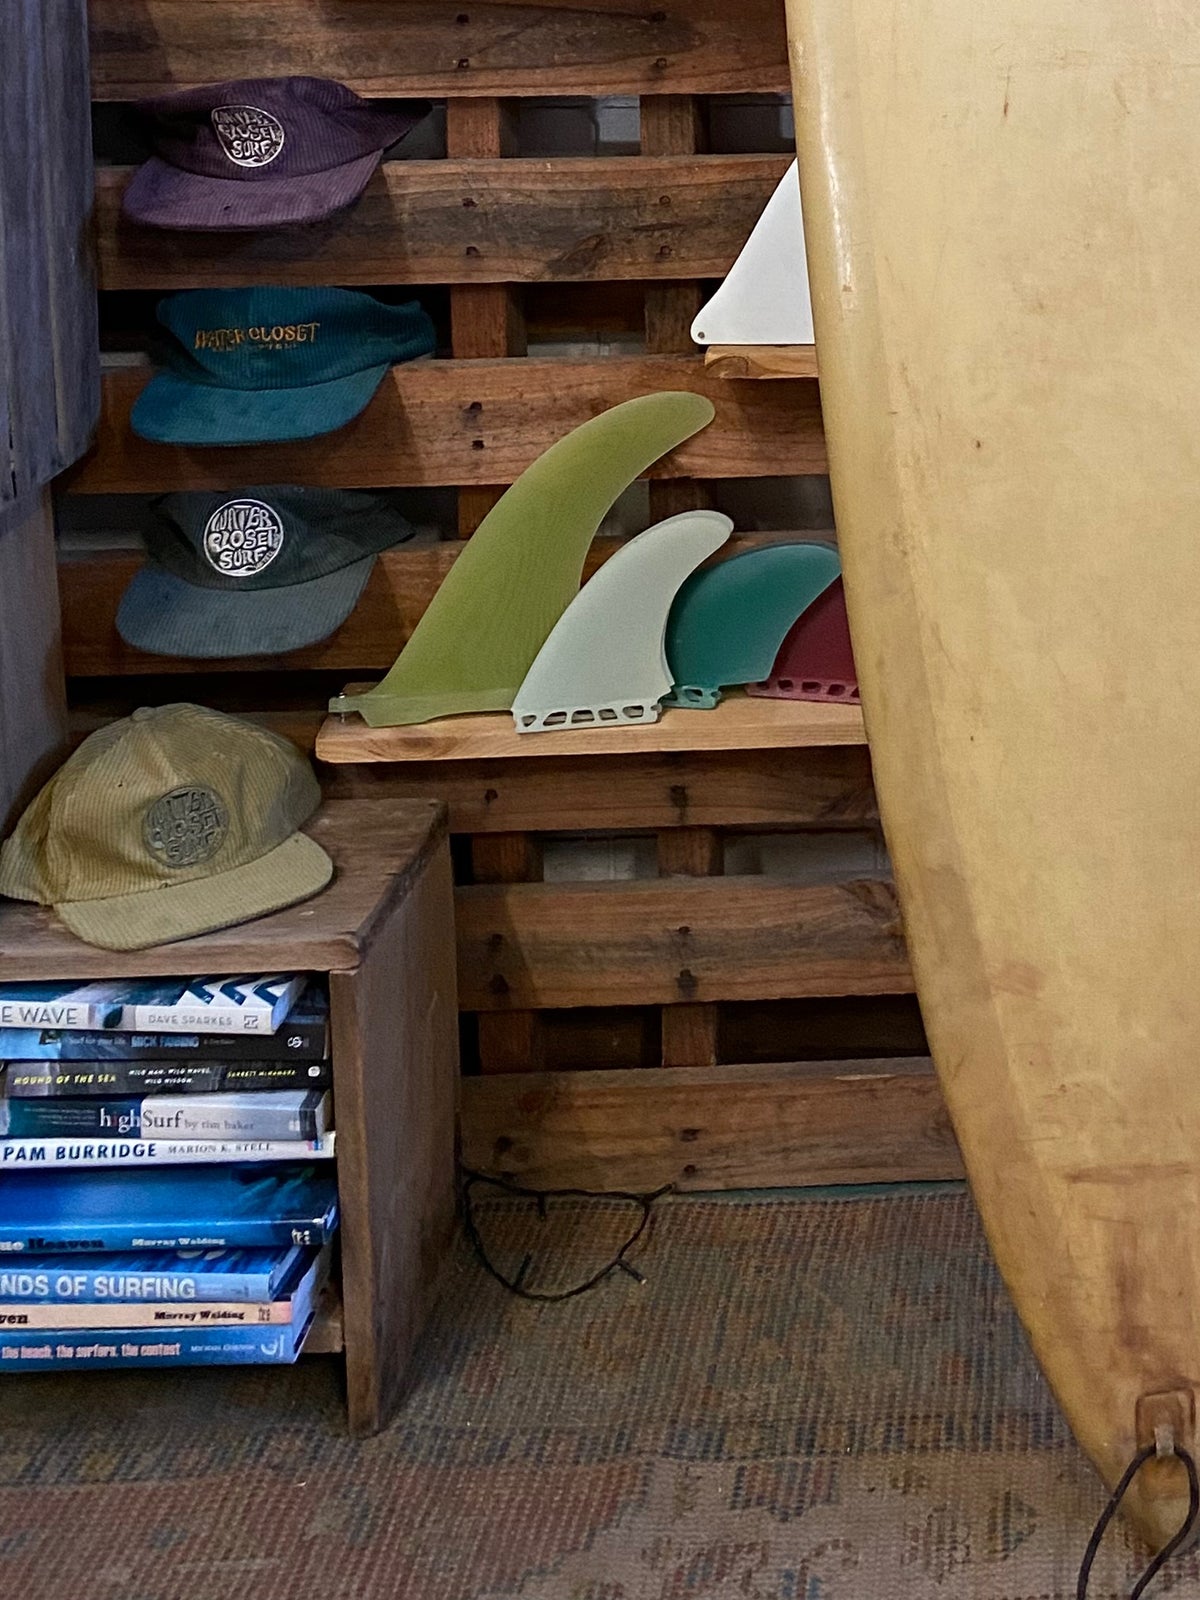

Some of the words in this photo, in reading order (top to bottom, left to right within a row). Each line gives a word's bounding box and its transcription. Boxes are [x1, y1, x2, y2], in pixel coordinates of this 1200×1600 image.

[231, 140, 271, 158] SURF
[248, 322, 321, 343] CLOSET
[211, 505, 272, 532] WATER
[207, 526, 278, 553] CLOSET
[219, 547, 267, 569] SURF
[20, 1007, 78, 1025] WAVE
[149, 1014, 178, 1025] DAVE
[183, 1015, 233, 1026] SPARKES
[14, 1076, 52, 1086] HOUND
[56, 1076, 71, 1085] OF
[74, 1074, 93, 1084] THE
[97, 1074, 117, 1084] SEA
[184, 1120, 198, 1131] by
[201, 1118, 220, 1130] tim
[224, 1119, 255, 1131] baker
[3, 1146, 46, 1161] PAM
[56, 1143, 157, 1160] BURRIDGE
[168, 1144, 216, 1154] MARION
[28, 1237, 105, 1249] Heaven
[0, 1274, 49, 1296] NDS
[55, 1275, 88, 1297] OF
[93, 1275, 196, 1299] SURFING
[0, 1313, 29, 1324] ven
[154, 1311, 198, 1321] Murray
[199, 1310, 245, 1320] Walding
